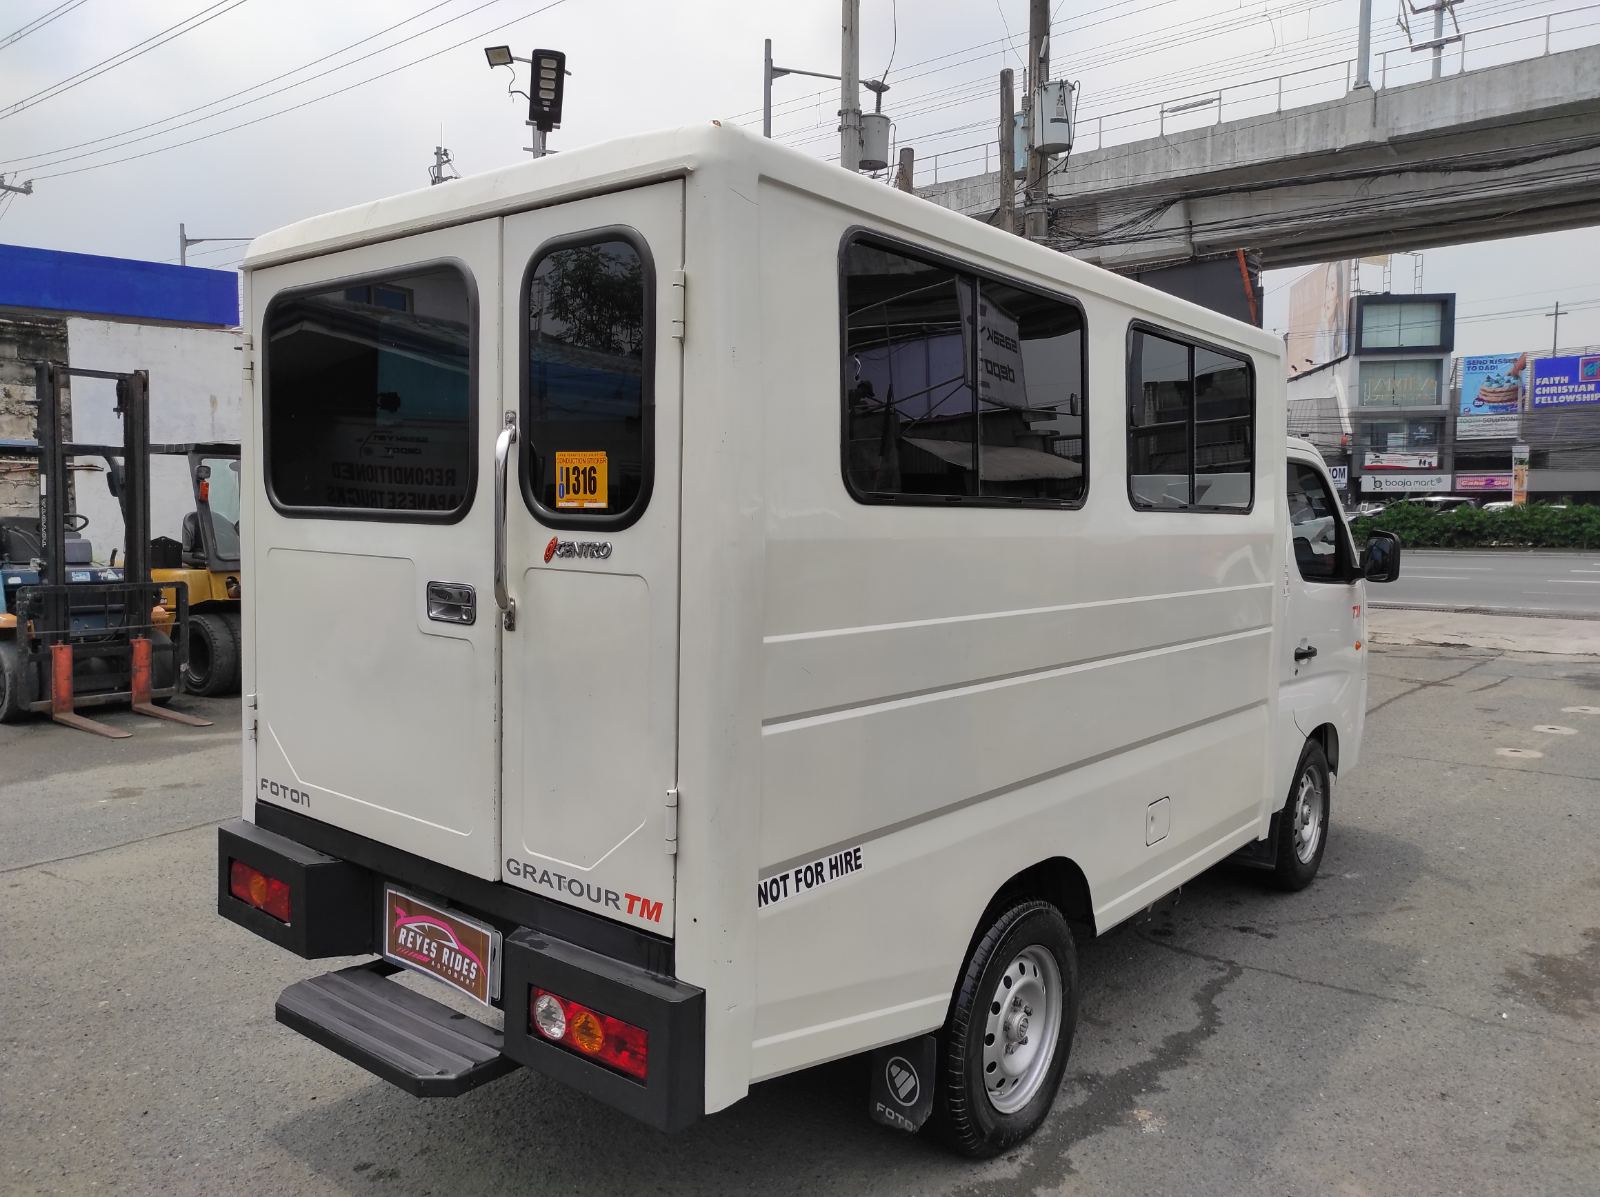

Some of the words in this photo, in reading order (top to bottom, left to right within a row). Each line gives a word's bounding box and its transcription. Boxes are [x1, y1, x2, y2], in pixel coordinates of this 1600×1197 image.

[1535, 376, 1569, 386] FAITH
[1535, 384, 1595, 395] CHRISTIAN
[1535, 393, 1600, 404] FELLOWSHIP
[1329, 467, 1346, 479] OM
[1385, 478, 1412, 487] booja
[1413, 479, 1436, 487] mart
[555, 541, 613, 560] CENTRO
[261, 778, 310, 808] FOTON
[757, 873, 789, 908] NOT
[794, 861, 826, 893] FOR
[828, 846, 863, 880] HIRE
[506, 858, 621, 911] GRATOUR
[624, 893, 664, 923] TM
[398, 928, 438, 958] REYES
[441, 947, 478, 980] RIDES
[431, 960, 475, 988] AUTOMART
